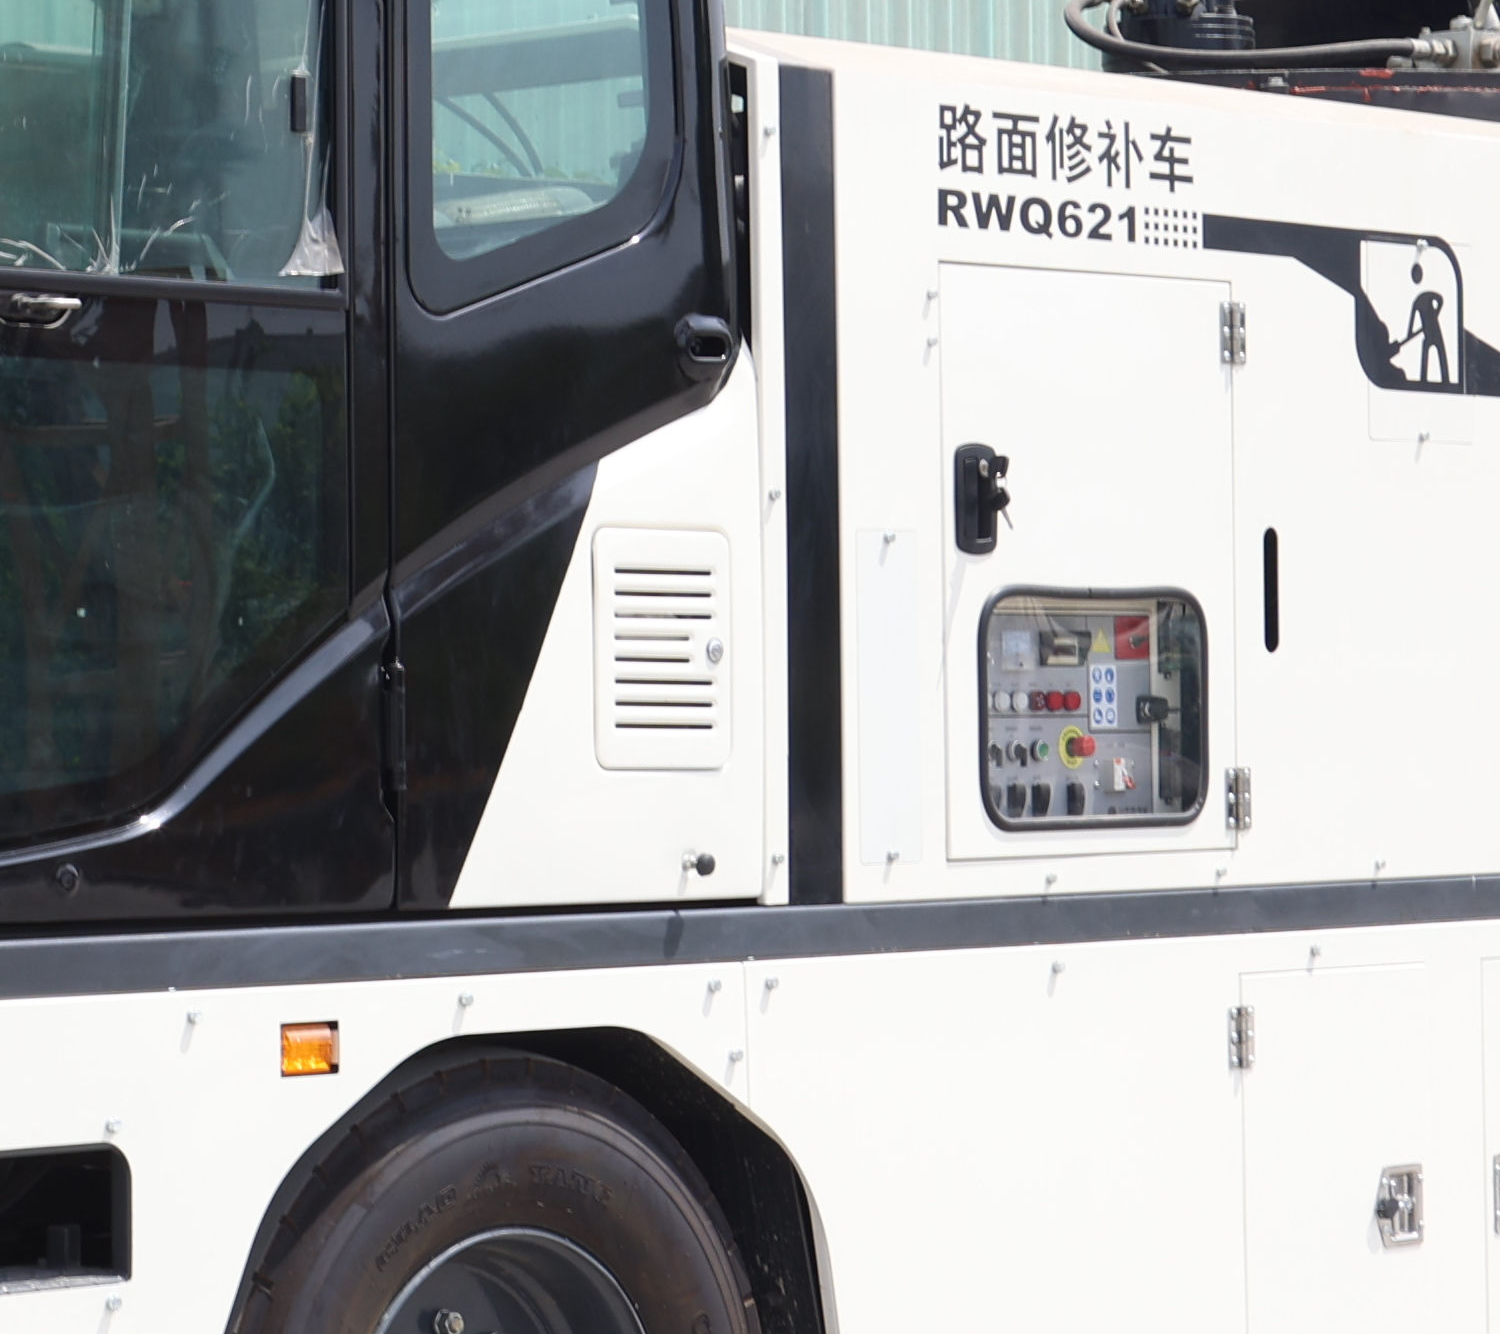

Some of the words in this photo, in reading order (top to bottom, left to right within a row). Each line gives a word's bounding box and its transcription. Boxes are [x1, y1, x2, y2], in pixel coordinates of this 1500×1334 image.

[938, 103, 1194, 193] 路面修补车
[938, 188, 1136, 242] RWQ621
